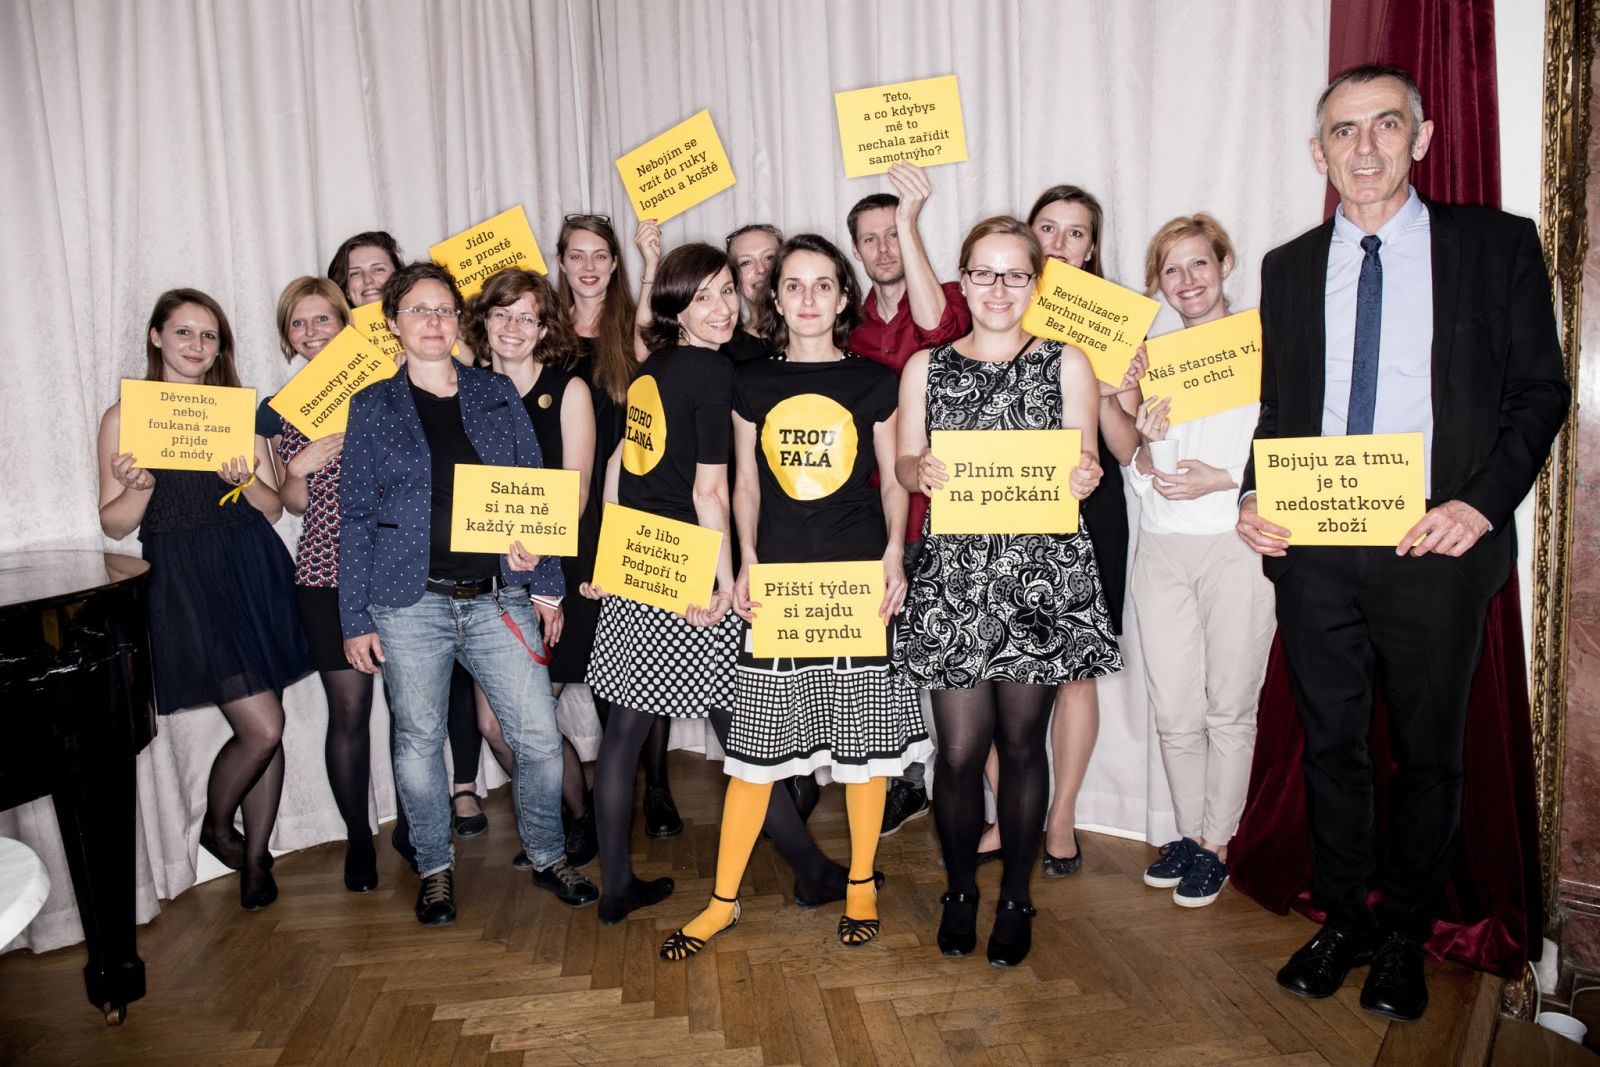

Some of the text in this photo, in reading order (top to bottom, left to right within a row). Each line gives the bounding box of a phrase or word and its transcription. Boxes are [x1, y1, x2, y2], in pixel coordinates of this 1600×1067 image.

[883, 92, 911, 102] Teto,
[875, 110, 887, 119] co
[892, 104, 936, 116] kdybys
[886, 120, 918, 132] mě to
[858, 130, 950, 151] nechala zařídit
[636, 138, 698, 178] Nebojím se
[868, 146, 942, 164] samotnýho?
[638, 150, 706, 192] vzít do ruky
[640, 186, 676, 210] lopatu
[687, 161, 718, 185] koště
[466, 232, 494, 250] Jídlo
[460, 238, 511, 270] se prostě
[456, 252, 526, 288] nevyhazuje,
[1052, 286, 1128, 326] Revitalizace?
[1036, 296, 1084, 325] Navrhnu
[1088, 318, 1110, 337] vám
[1045, 317, 1108, 352] Bez legrace
[1148, 364, 1176, 381] Náš
[1180, 348, 1237, 374] starosta
[300, 352, 368, 416] Stereotyp out,
[1184, 366, 1234, 390] co chci
[160, 391, 217, 406] Děvenko,
[312, 359, 381, 428] rozmanitost in
[172, 408, 208, 420] neboj,
[628, 406, 652, 428] ODHO
[148, 419, 231, 433] foukaná zase
[172, 435, 208, 447] přijde
[779, 429, 836, 446] TROU
[161, 448, 213, 461] do módy
[780, 449, 832, 468] FALÁ
[1267, 451, 1409, 471] Bojuju za tmu,
[954, 462, 1057, 481] Plním sny
[490, 480, 546, 496] Sahám
[1316, 474, 1358, 493] je to
[950, 485, 1060, 506] na počkání
[1275, 495, 1405, 511] nedostatkové
[484, 500, 549, 516] si na ně
[465, 518, 567, 536] každý měsíc
[1317, 517, 1367, 533] zboží
[636, 524, 680, 546] Je libo
[626, 540, 689, 564] kávičku?
[622, 554, 687, 583] Podpoří to
[624, 574, 678, 598] Barušku
[764, 580, 871, 598] Příští týden
[784, 602, 854, 621] si zajdu
[777, 625, 862, 643] na gyndu
